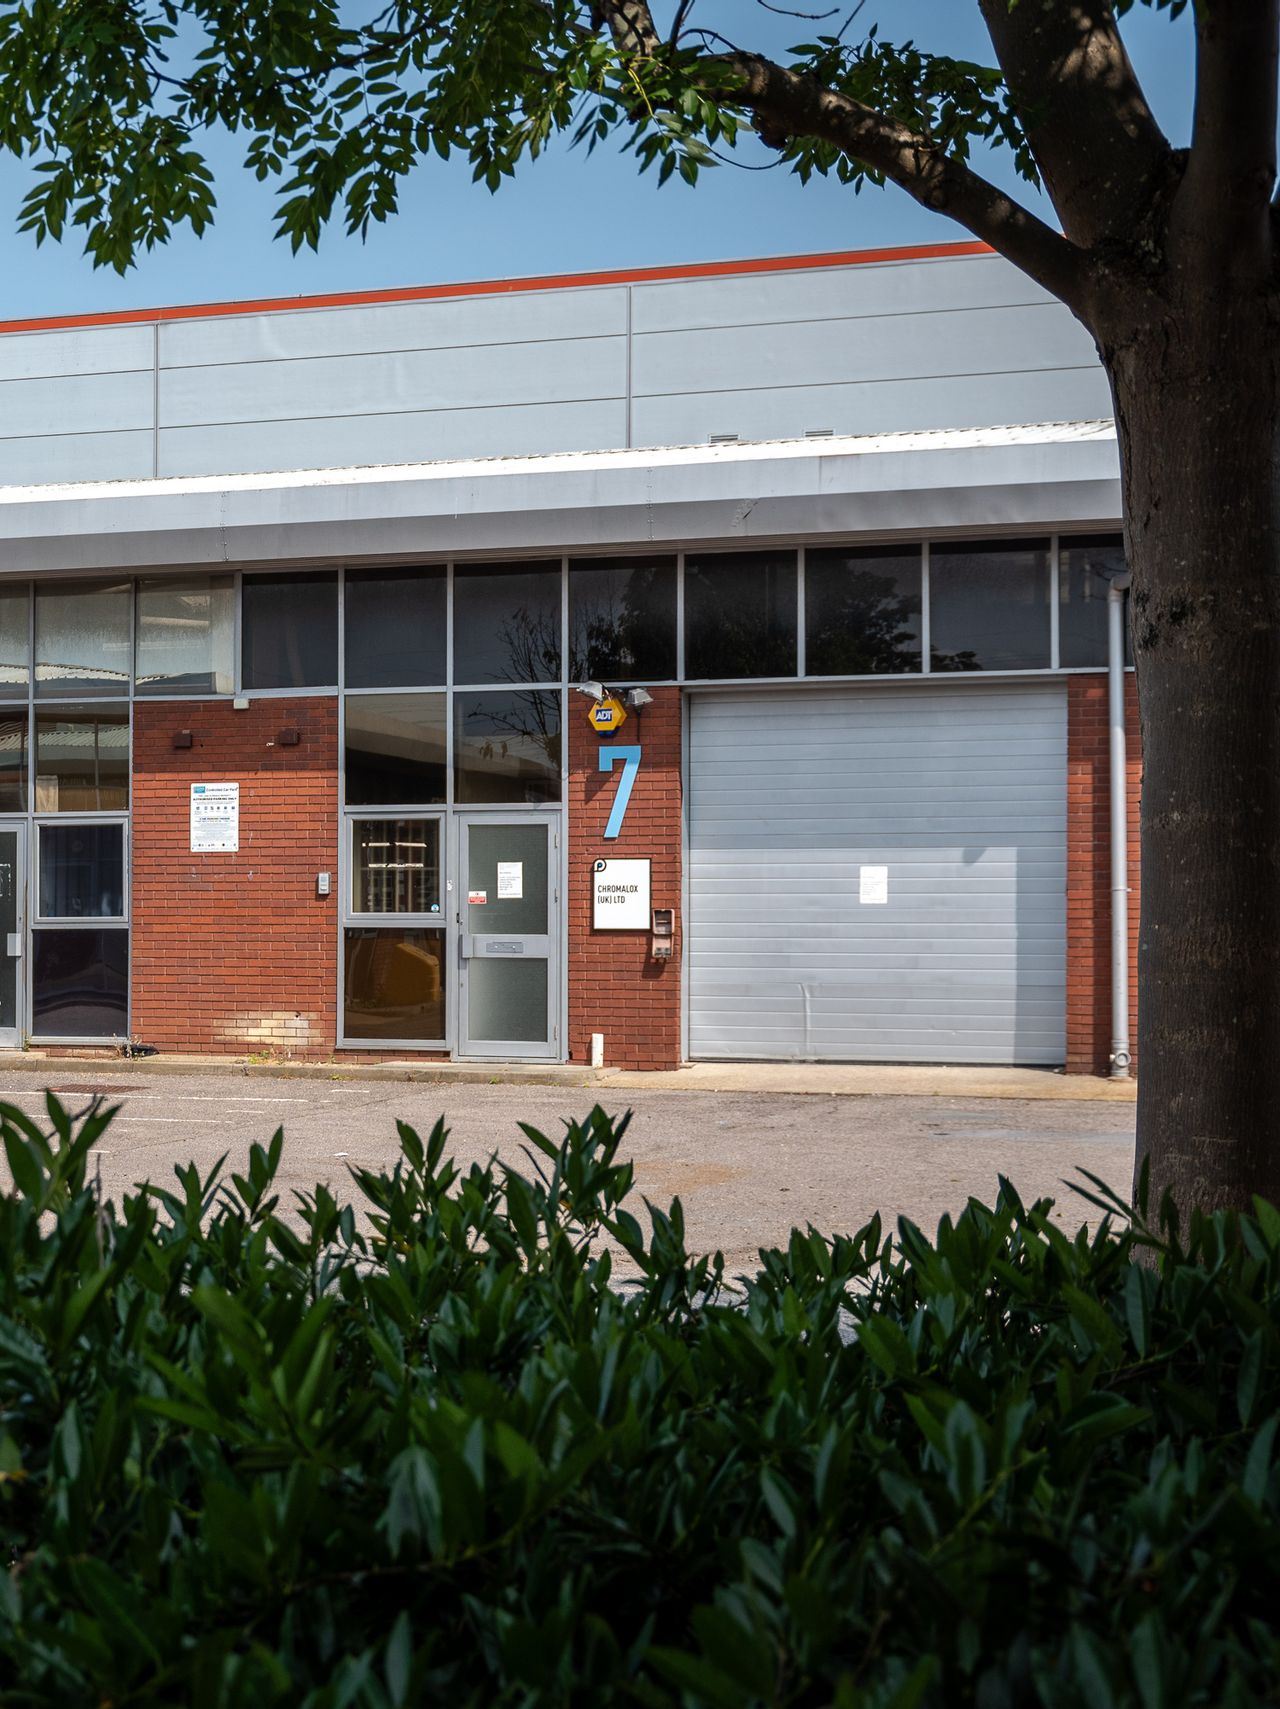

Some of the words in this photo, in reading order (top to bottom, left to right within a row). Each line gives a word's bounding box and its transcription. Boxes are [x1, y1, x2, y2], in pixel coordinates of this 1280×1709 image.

[596, 710, 613, 721] ADT
[598, 745, 642, 838] 7
[597, 884, 639, 893] CHROMALOX
[597, 895, 612, 904] (UK)
[613, 895, 626, 904] LTD
